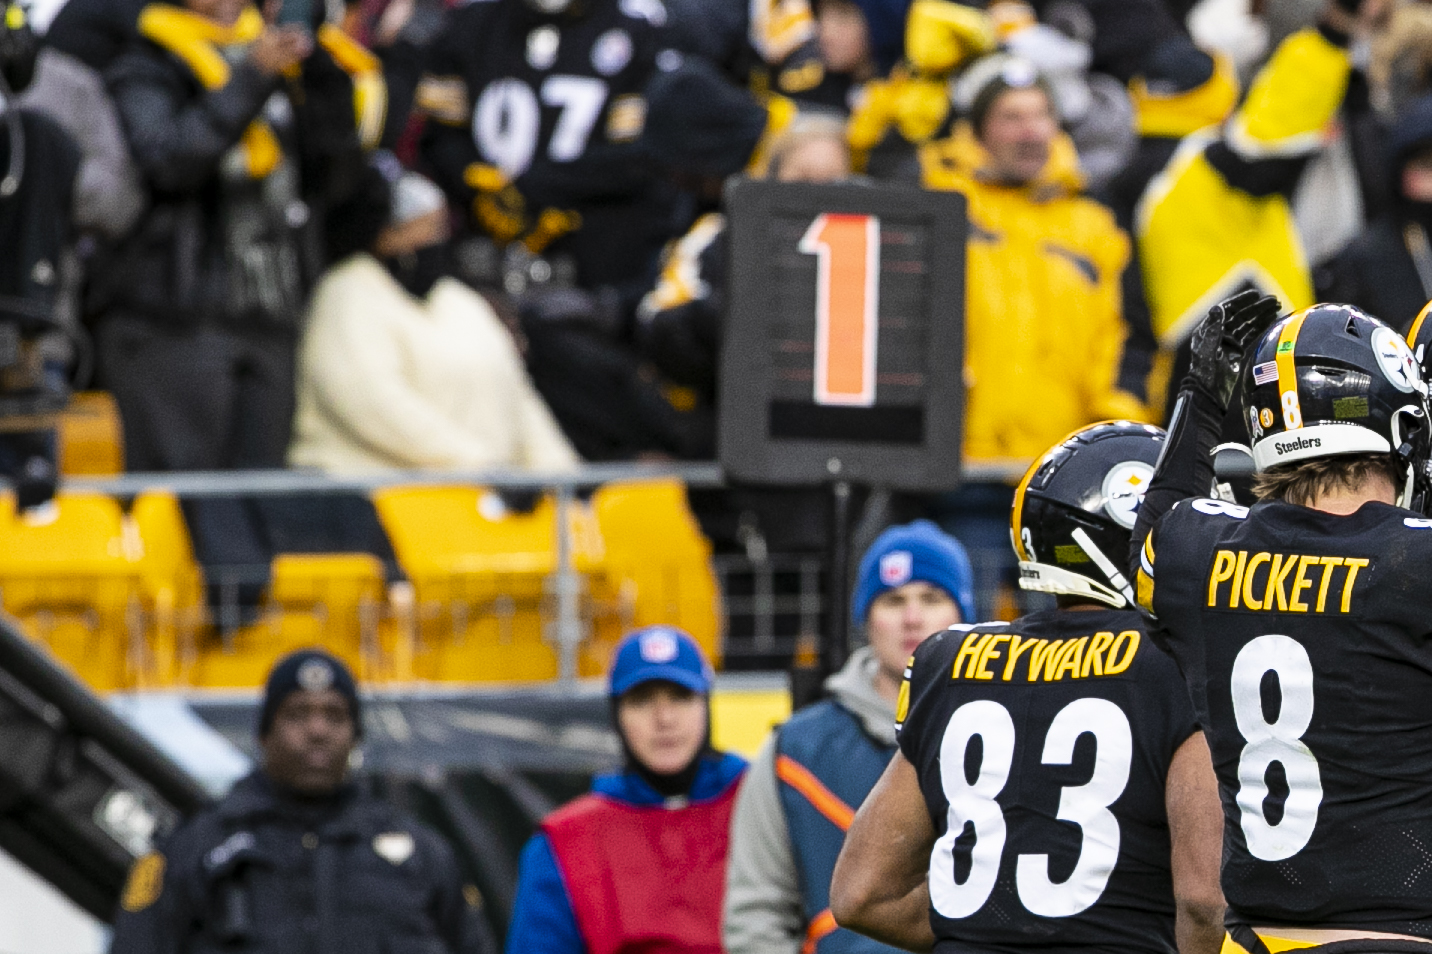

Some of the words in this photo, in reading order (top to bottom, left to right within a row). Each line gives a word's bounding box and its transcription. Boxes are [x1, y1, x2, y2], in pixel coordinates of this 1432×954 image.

[797, 213, 881, 407] 1
[1281, 390, 1301, 430] 8
[1274, 436, 1322, 456] Steelers
[1208, 549, 1370, 614] PICKETT
[951, 629, 1140, 684] HEYWARD
[1230, 634, 1324, 862] 8
[928, 697, 1133, 919] 83
